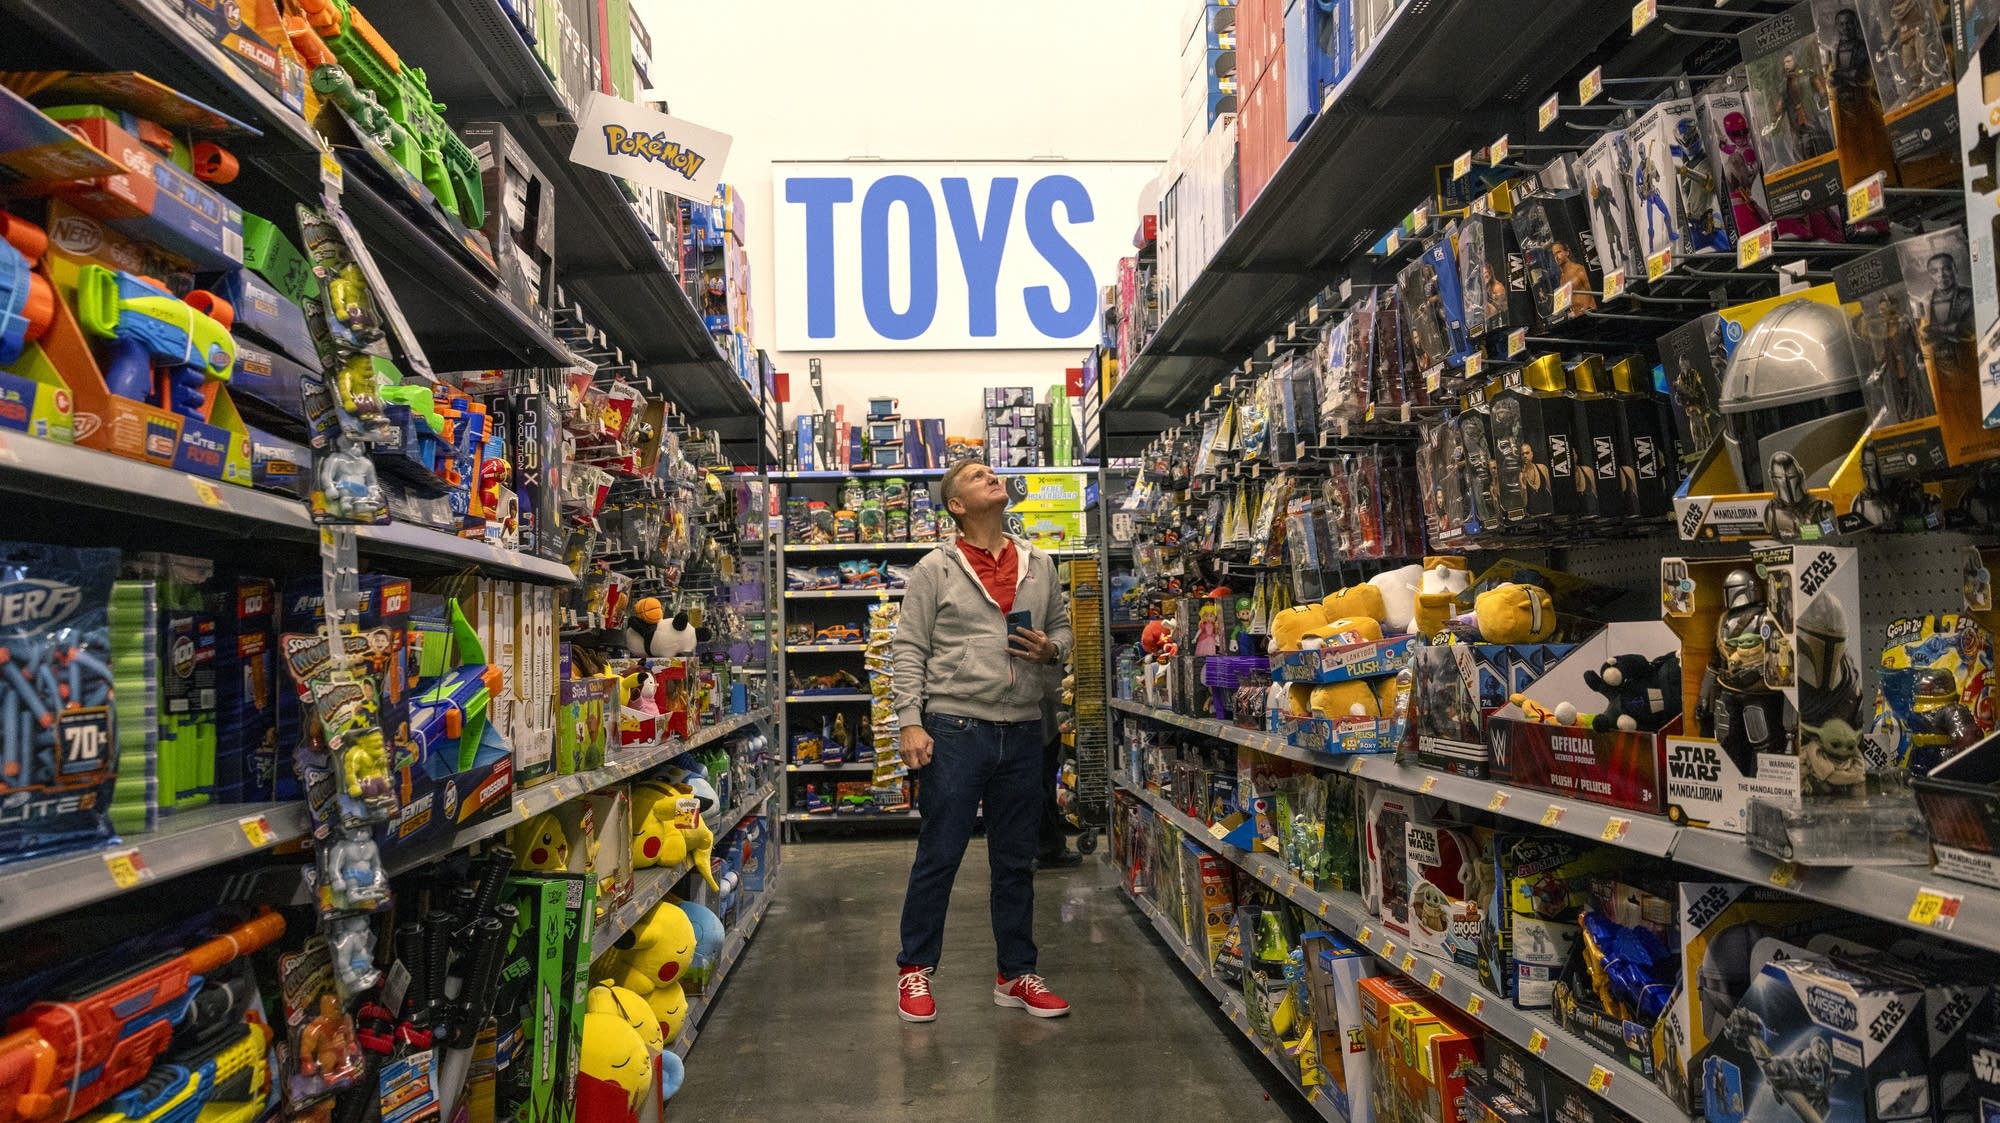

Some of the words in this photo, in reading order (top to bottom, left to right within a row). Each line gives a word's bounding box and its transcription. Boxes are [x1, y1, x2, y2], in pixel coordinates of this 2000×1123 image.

[1755, 14, 1793, 38] STAR
[1757, 23, 1796, 48] WARS
[238, 38, 276, 69] FALCON
[603, 124, 705, 181] Pokémon
[785, 174, 1098, 340] TOYS
[183, 430, 216, 451] ELITE
[524, 396, 538, 470] LASER
[269, 463, 296, 474] FORCE
[524, 472, 539, 486] X
[1682, 502, 1699, 531] STAR
[1685, 509, 1704, 539] WARS
[1713, 507, 1759, 520] MANDALORIAN
[1752, 549, 1792, 560] GALACTIC
[1762, 555, 1790, 563] ACTION
[1800, 551, 1833, 589] STAR
[1802, 556, 1838, 597] WARS
[2, 586, 82, 627] ERF
[1346, 660, 1380, 677] PLUSH
[1551, 735, 1595, 755] OFFICIAL
[1668, 746, 1721, 766] STAR
[1863, 744, 1885, 768] WARS
[1864, 738, 1888, 763] STAR
[1554, 753, 1574, 763] LICENSED
[1574, 755, 1596, 765] PRODUCT
[1669, 761, 1722, 782] WARS
[1550, 774, 1573, 788] PLUSH
[1581, 779, 1612, 795] PELUCHE
[1642, 789, 1652, 802] 3+
[1669, 783, 1723, 803] MANDALORIAN
[1738, 783, 1749, 792] THE
[1750, 784, 1793, 798] MANDALORIAN
[1408, 829, 1434, 841] STAR
[1408, 838, 1436, 852] WARS
[1948, 853, 1992, 870] MANDALORIAN
[1686, 884, 1724, 924] STAR
[1691, 890, 1731, 931] WARS
[1453, 921, 1480, 934] GROGU
[502, 956, 529, 983] 155
[1808, 993, 1856, 1022] MISSION
[1869, 1001, 1901, 1038] STAR
[542, 985, 551, 1082] STORM
[1576, 1009, 1593, 1027] POWER
[1598, 1015, 1623, 1037] RANGERS
[1873, 1005, 1906, 1043] WARS
